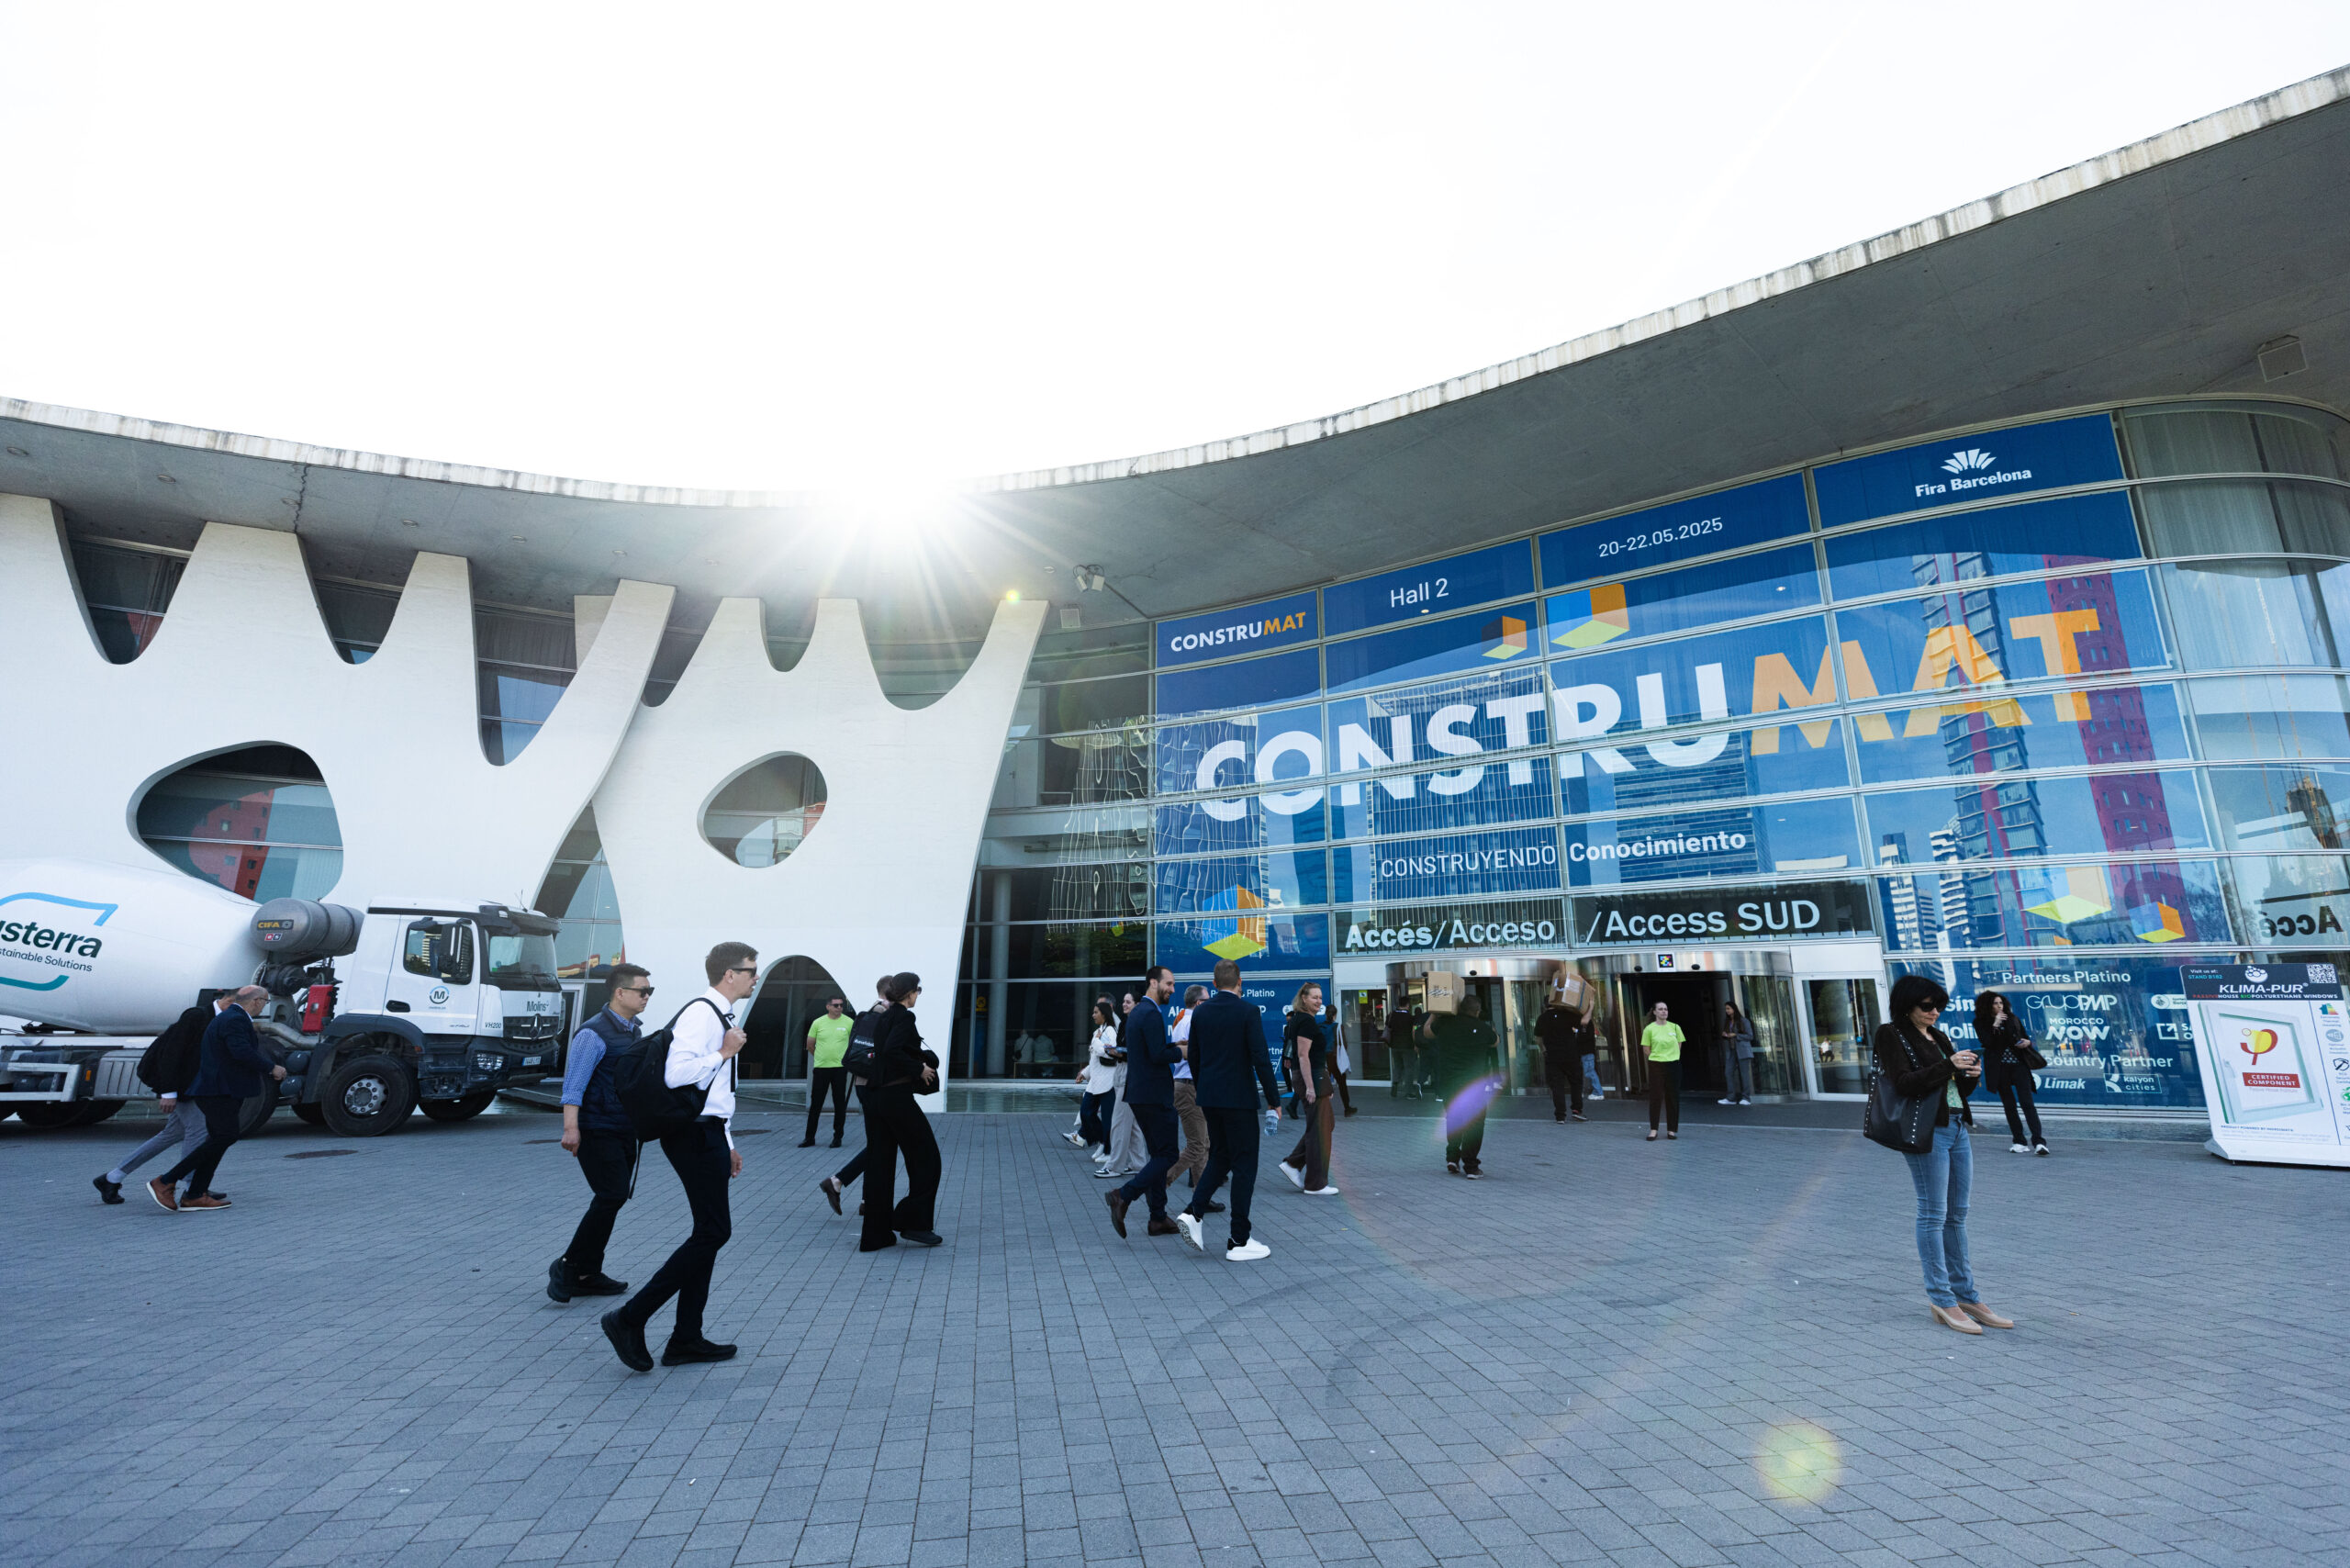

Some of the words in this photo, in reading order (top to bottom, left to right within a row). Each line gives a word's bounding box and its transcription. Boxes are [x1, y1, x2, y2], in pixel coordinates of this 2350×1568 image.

[1915, 483, 1946, 498] Fira
[1950, 469, 2032, 491] Barcelona
[1598, 517, 1724, 557] 20-22.05.2025
[1390, 583, 1429, 608] Hall
[1435, 577, 1449, 597] 2
[1170, 611, 1306, 652] CONSTRUMAT
[1195, 608, 2100, 823] CONSTRUMAT
[1381, 845, 1557, 878] CONSTRUYENDO
[1569, 830, 1746, 863] Conocimiento
[1737, 900, 1820, 932] SUD
[258, 921, 280, 929] CIFA
[44, 955, 93, 972] Solutions
[2001, 971, 2071, 984] Partners
[2075, 970, 2131, 982] Platino
[1247, 989, 1275, 997] Platino
[526, 1001, 547, 1013] Molins
[2049, 1017, 2104, 1025] MOROCCO
[2044, 1025, 2110, 1041] NOW
[2112, 1055, 2173, 1068] Partner
[2044, 1078, 2086, 1090] Limak
[2123, 1075, 2154, 1084] kalyon
